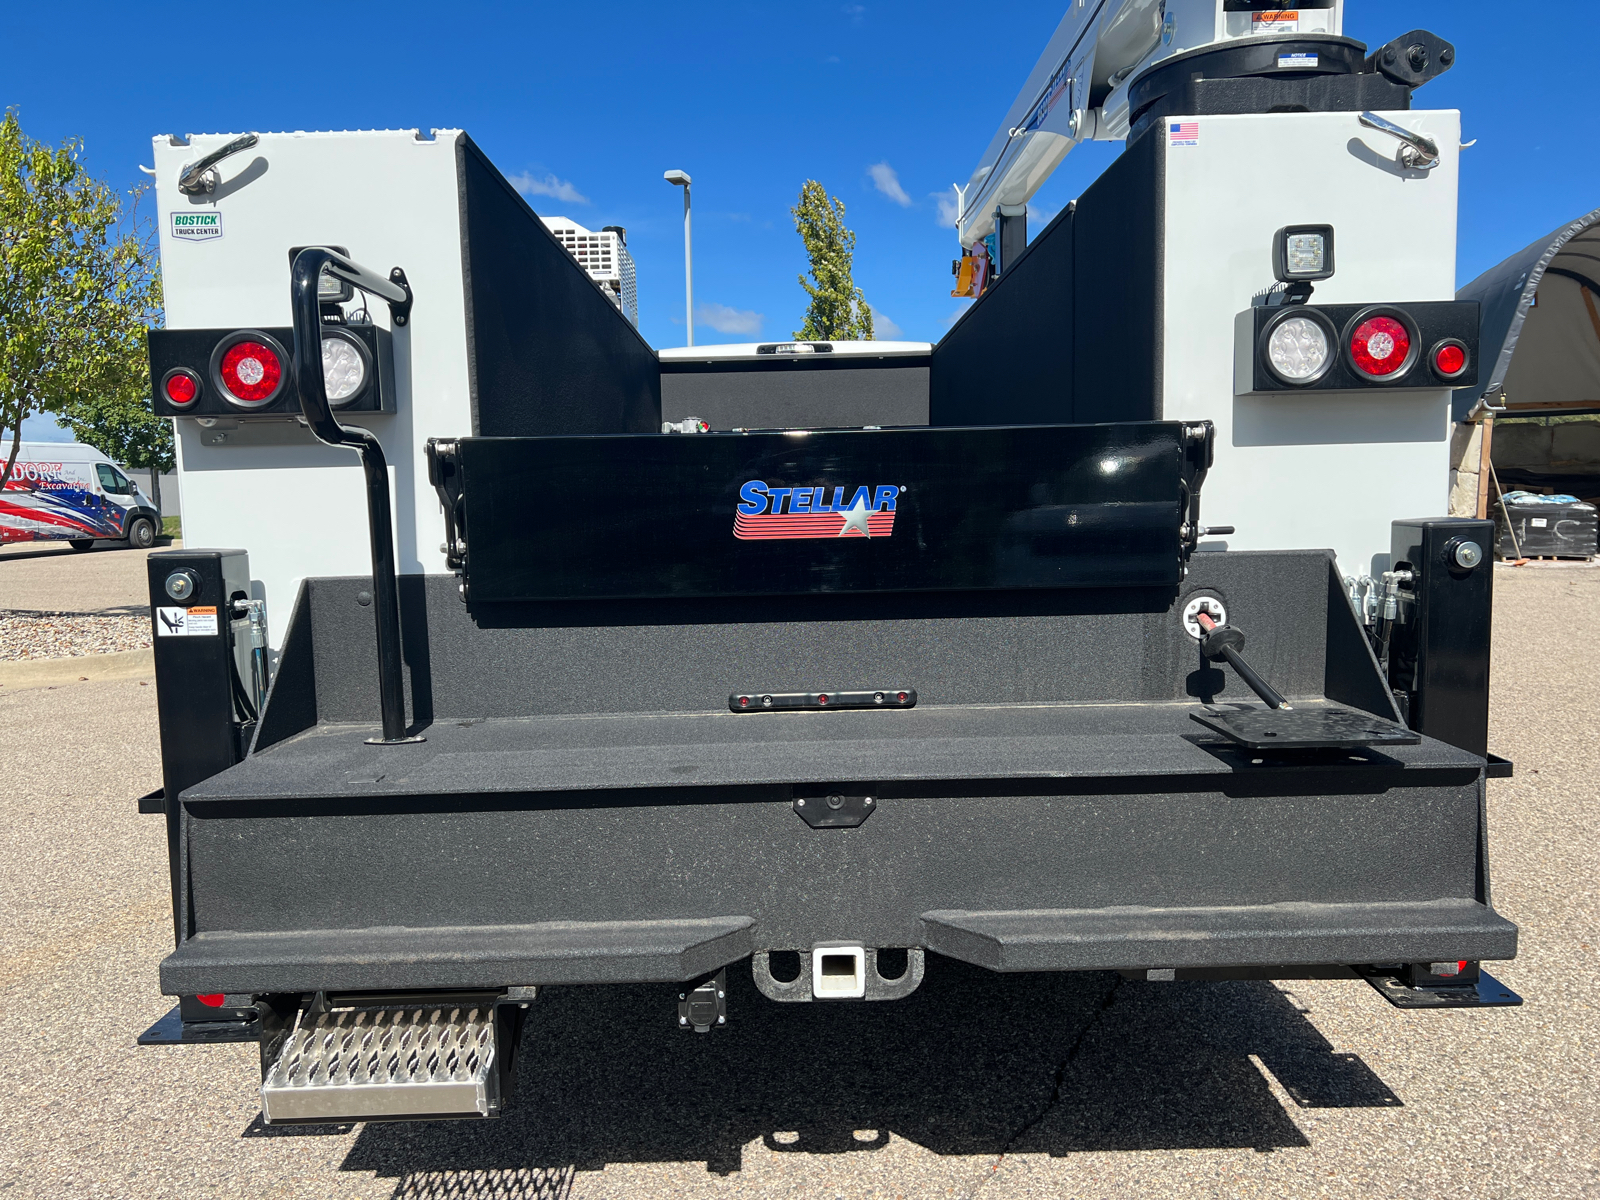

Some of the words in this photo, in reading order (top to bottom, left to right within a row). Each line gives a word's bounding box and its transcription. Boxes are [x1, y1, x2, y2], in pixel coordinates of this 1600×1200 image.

[175, 215, 218, 226] BOSTICK
[39, 479, 90, 492] Excavating
[736, 479, 900, 516] STELLAR
